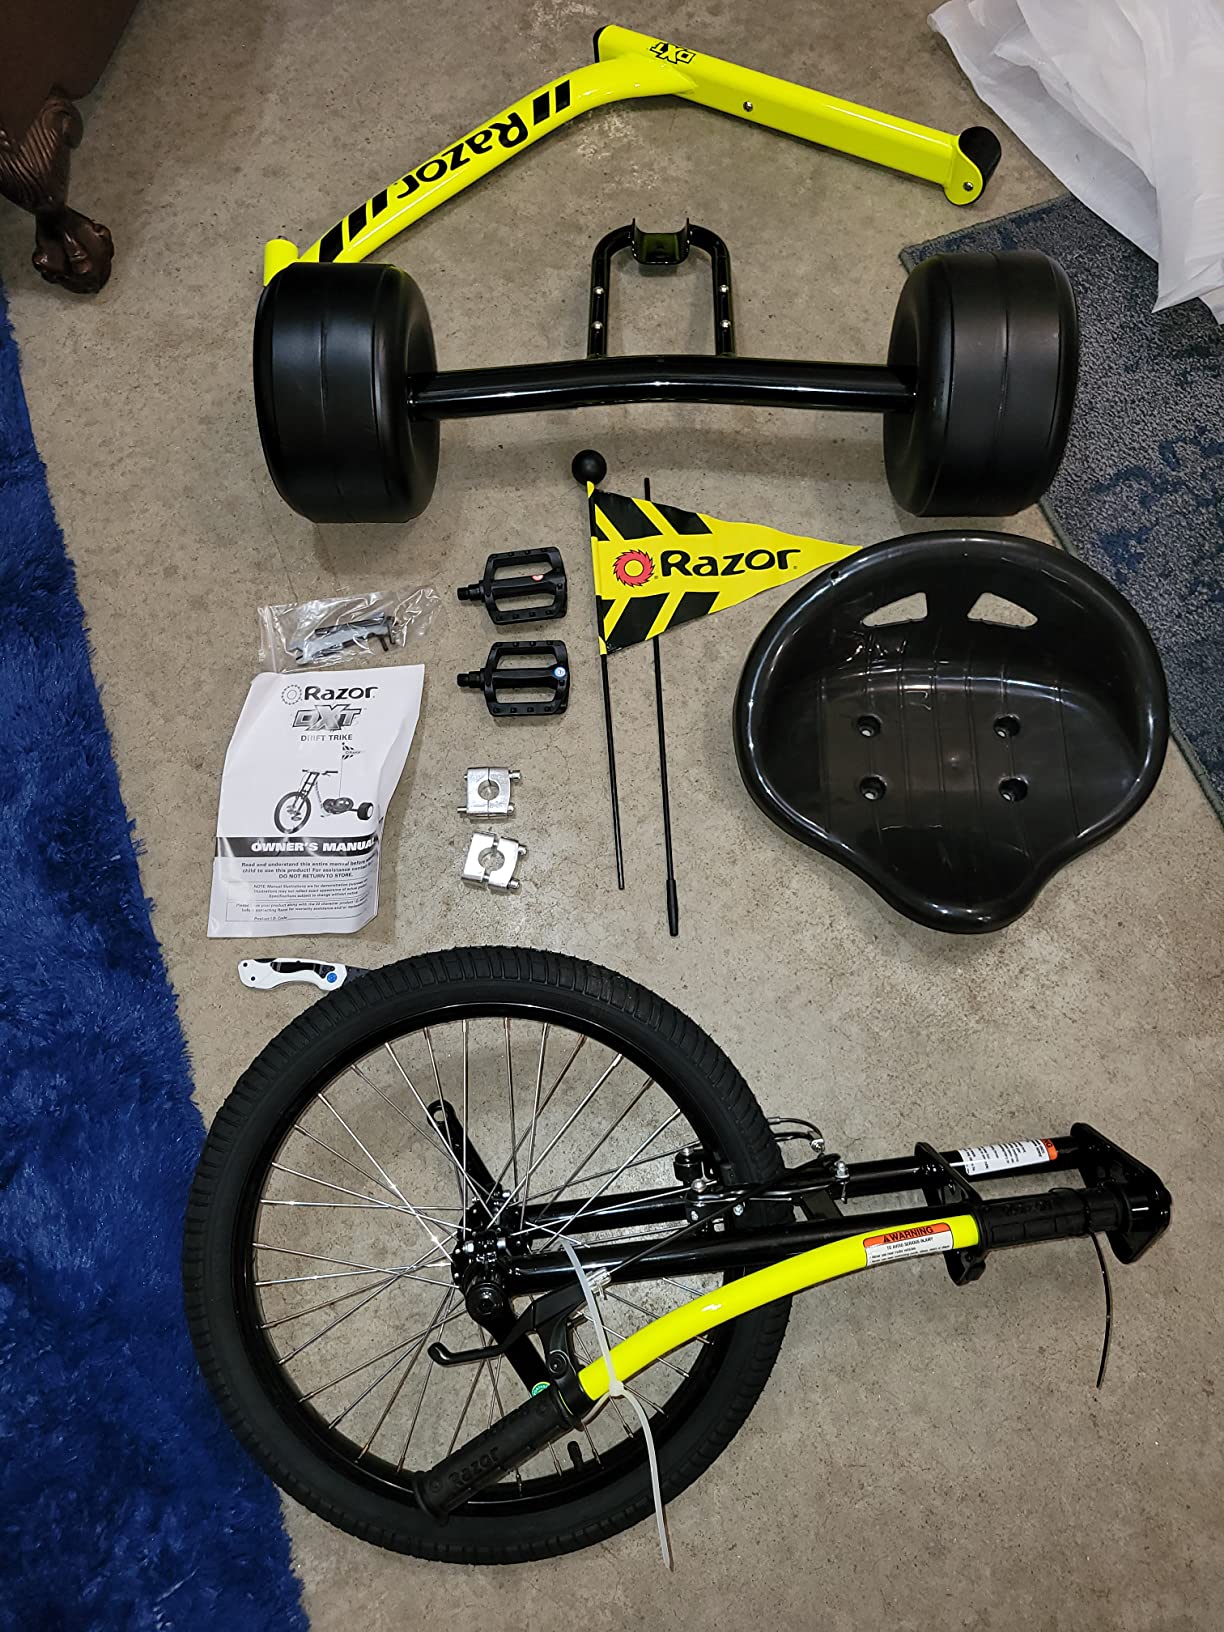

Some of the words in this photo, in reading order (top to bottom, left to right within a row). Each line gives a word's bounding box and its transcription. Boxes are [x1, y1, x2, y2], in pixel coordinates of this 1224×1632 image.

[649, 42, 696, 64] DXT
[396, 112, 528, 199] Razor
[660, 549, 801, 577] Razor
[304, 686, 378, 700] Razor
[292, 704, 362, 731] DXT
[250, 841, 319, 852] OWNER'S
[890, 1226, 934, 1242] WARNING
[448, 1446, 499, 1488] Razor
